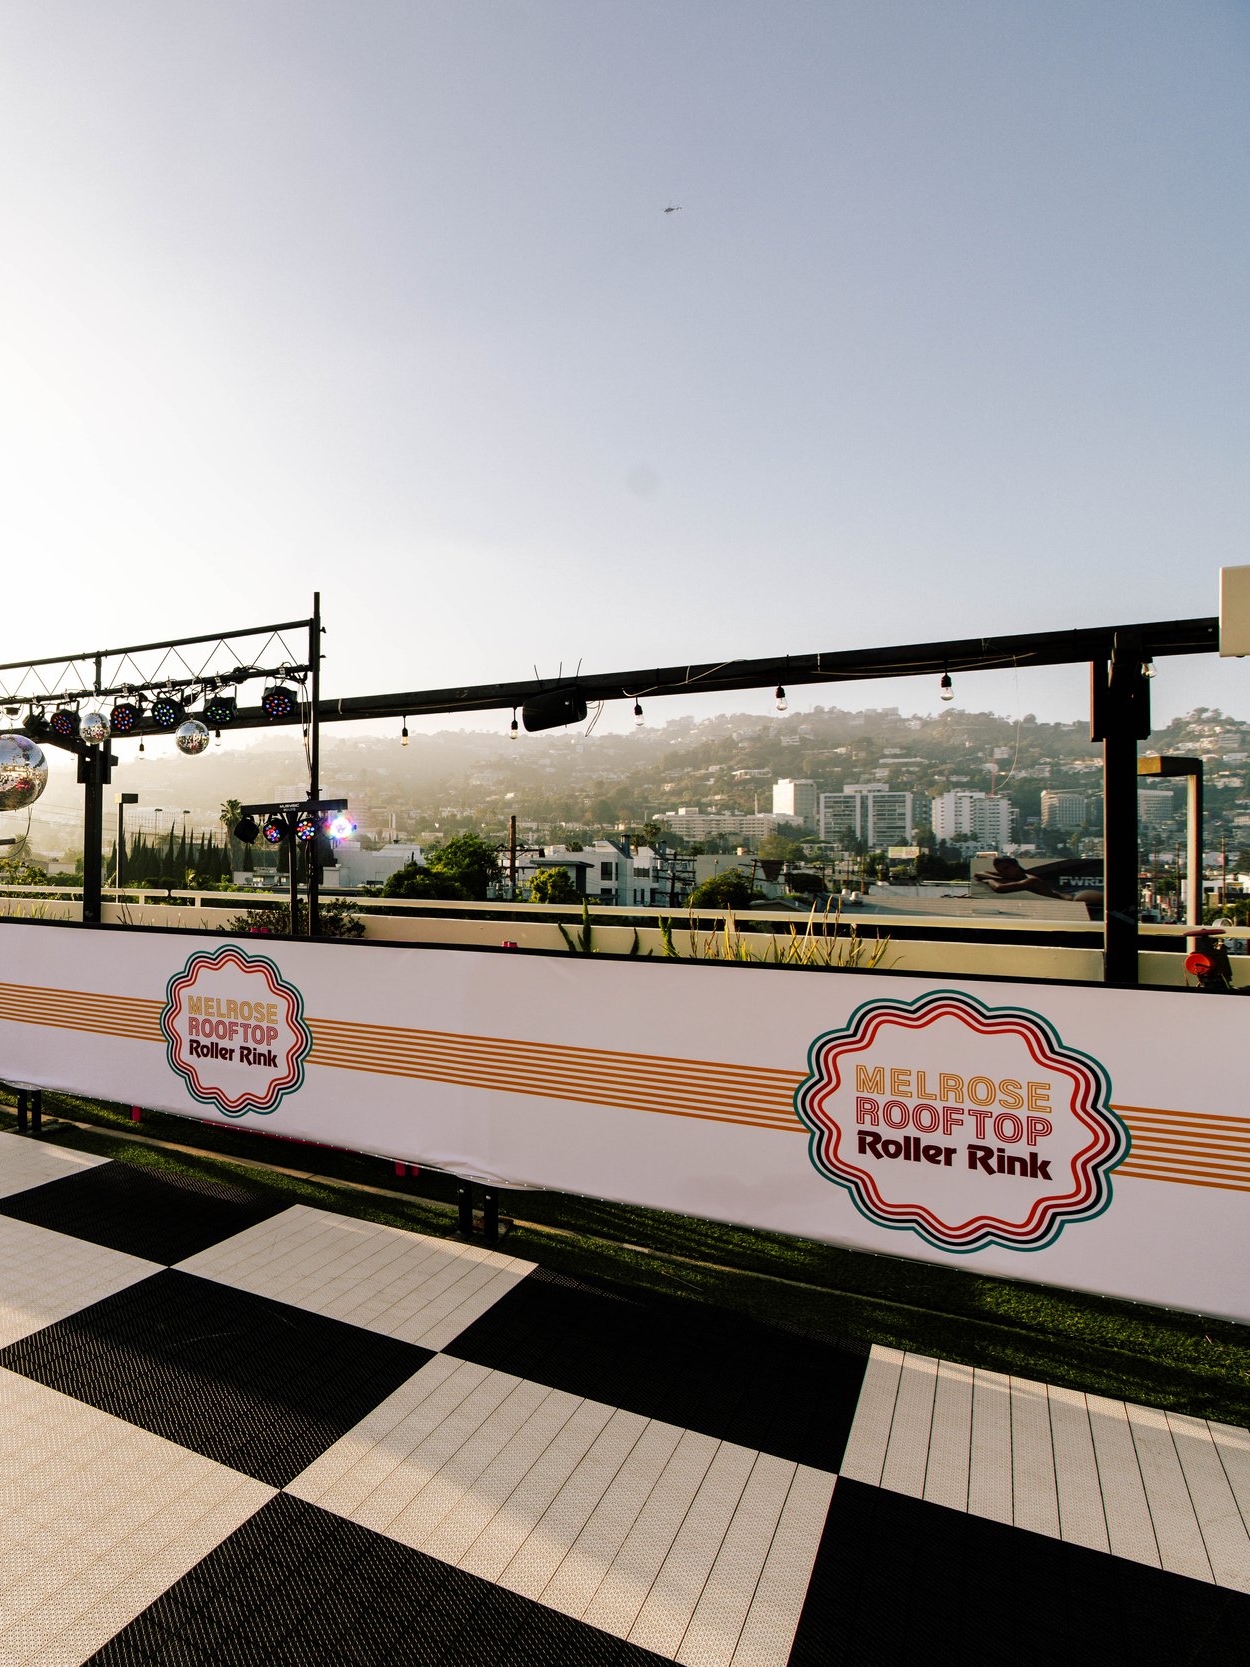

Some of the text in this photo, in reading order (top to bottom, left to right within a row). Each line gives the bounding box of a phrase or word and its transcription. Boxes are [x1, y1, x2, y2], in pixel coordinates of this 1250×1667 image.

[187, 995, 279, 1025] MELROSE
[188, 1016, 279, 1046] ROOFTOP
[189, 1039, 279, 1068] Roller Rink
[855, 1064, 1053, 1114] MELROSE
[855, 1096, 1053, 1147] ROOFTOP
[856, 1129, 1053, 1181] Roller Rink
